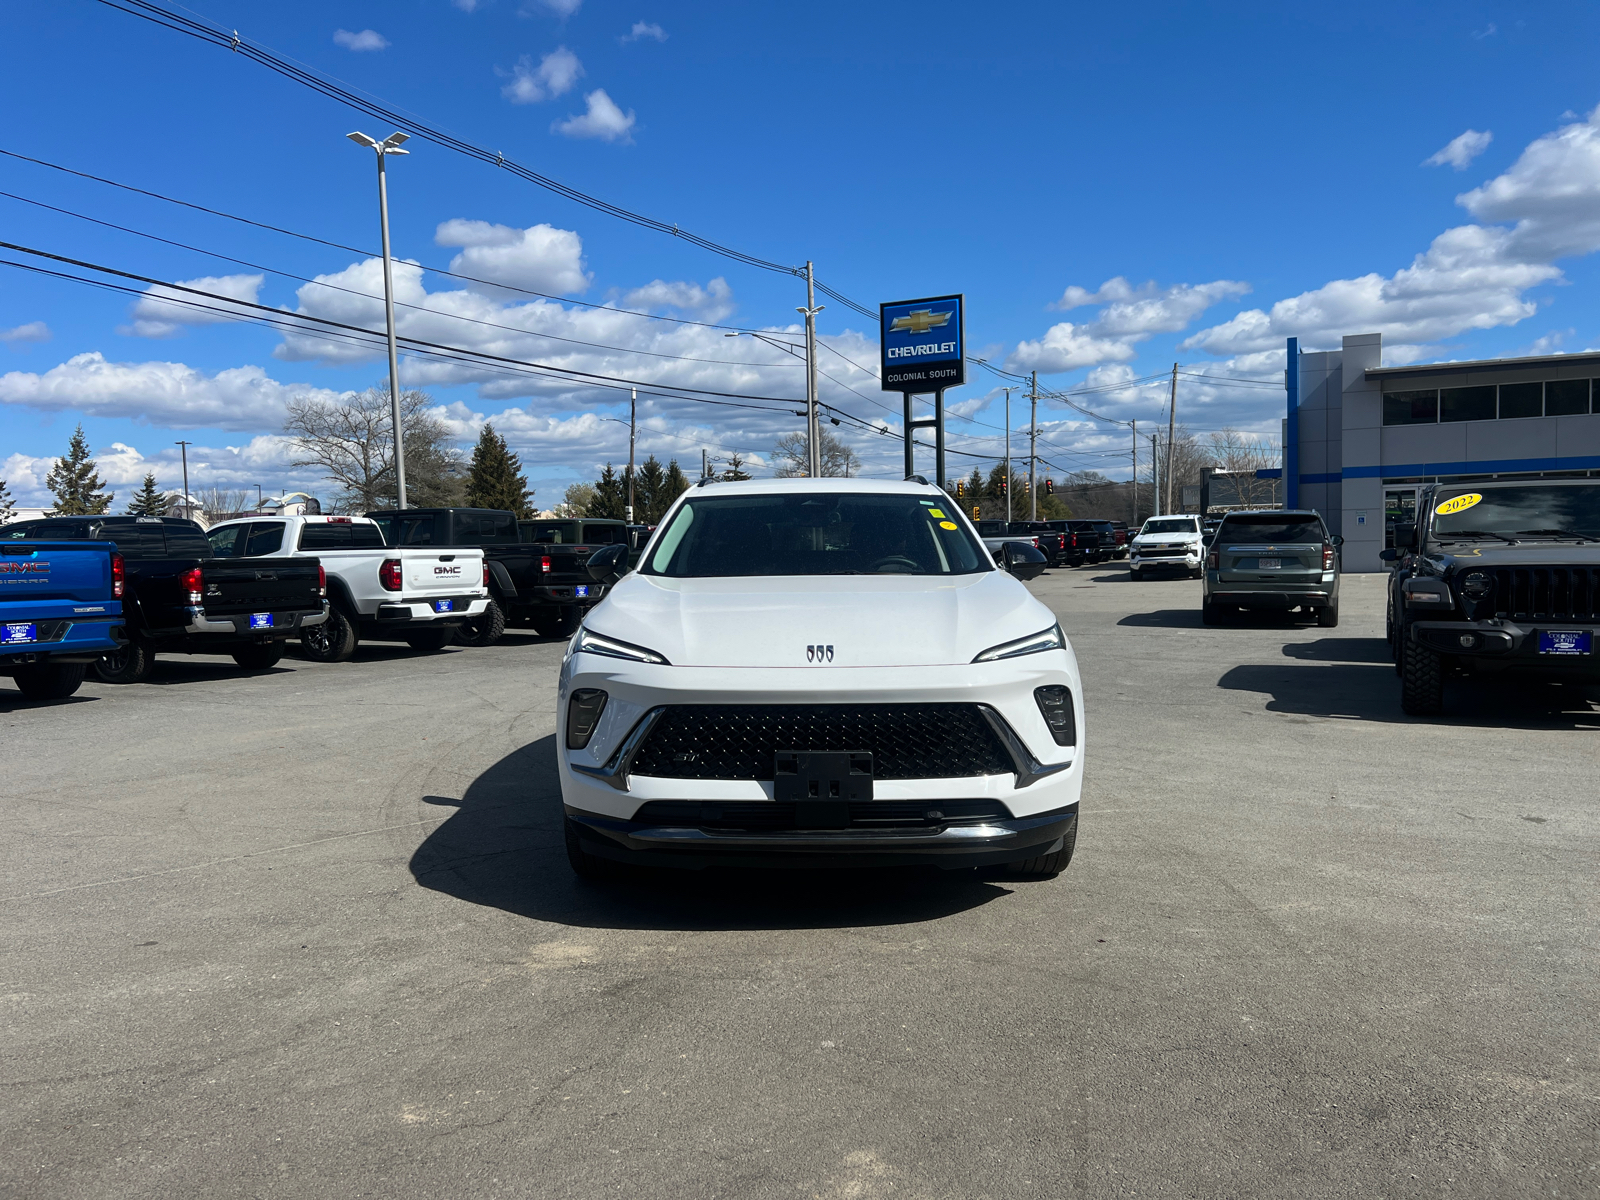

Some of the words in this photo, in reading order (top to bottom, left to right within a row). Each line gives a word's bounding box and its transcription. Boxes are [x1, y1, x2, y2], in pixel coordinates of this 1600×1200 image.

[887, 341, 956, 359] CHEVROLET
[887, 371, 927, 382] COLONIAL
[929, 368, 957, 379] SOUTH
[1445, 495, 1474, 513] 2022
[433, 566, 462, 574] GMC
